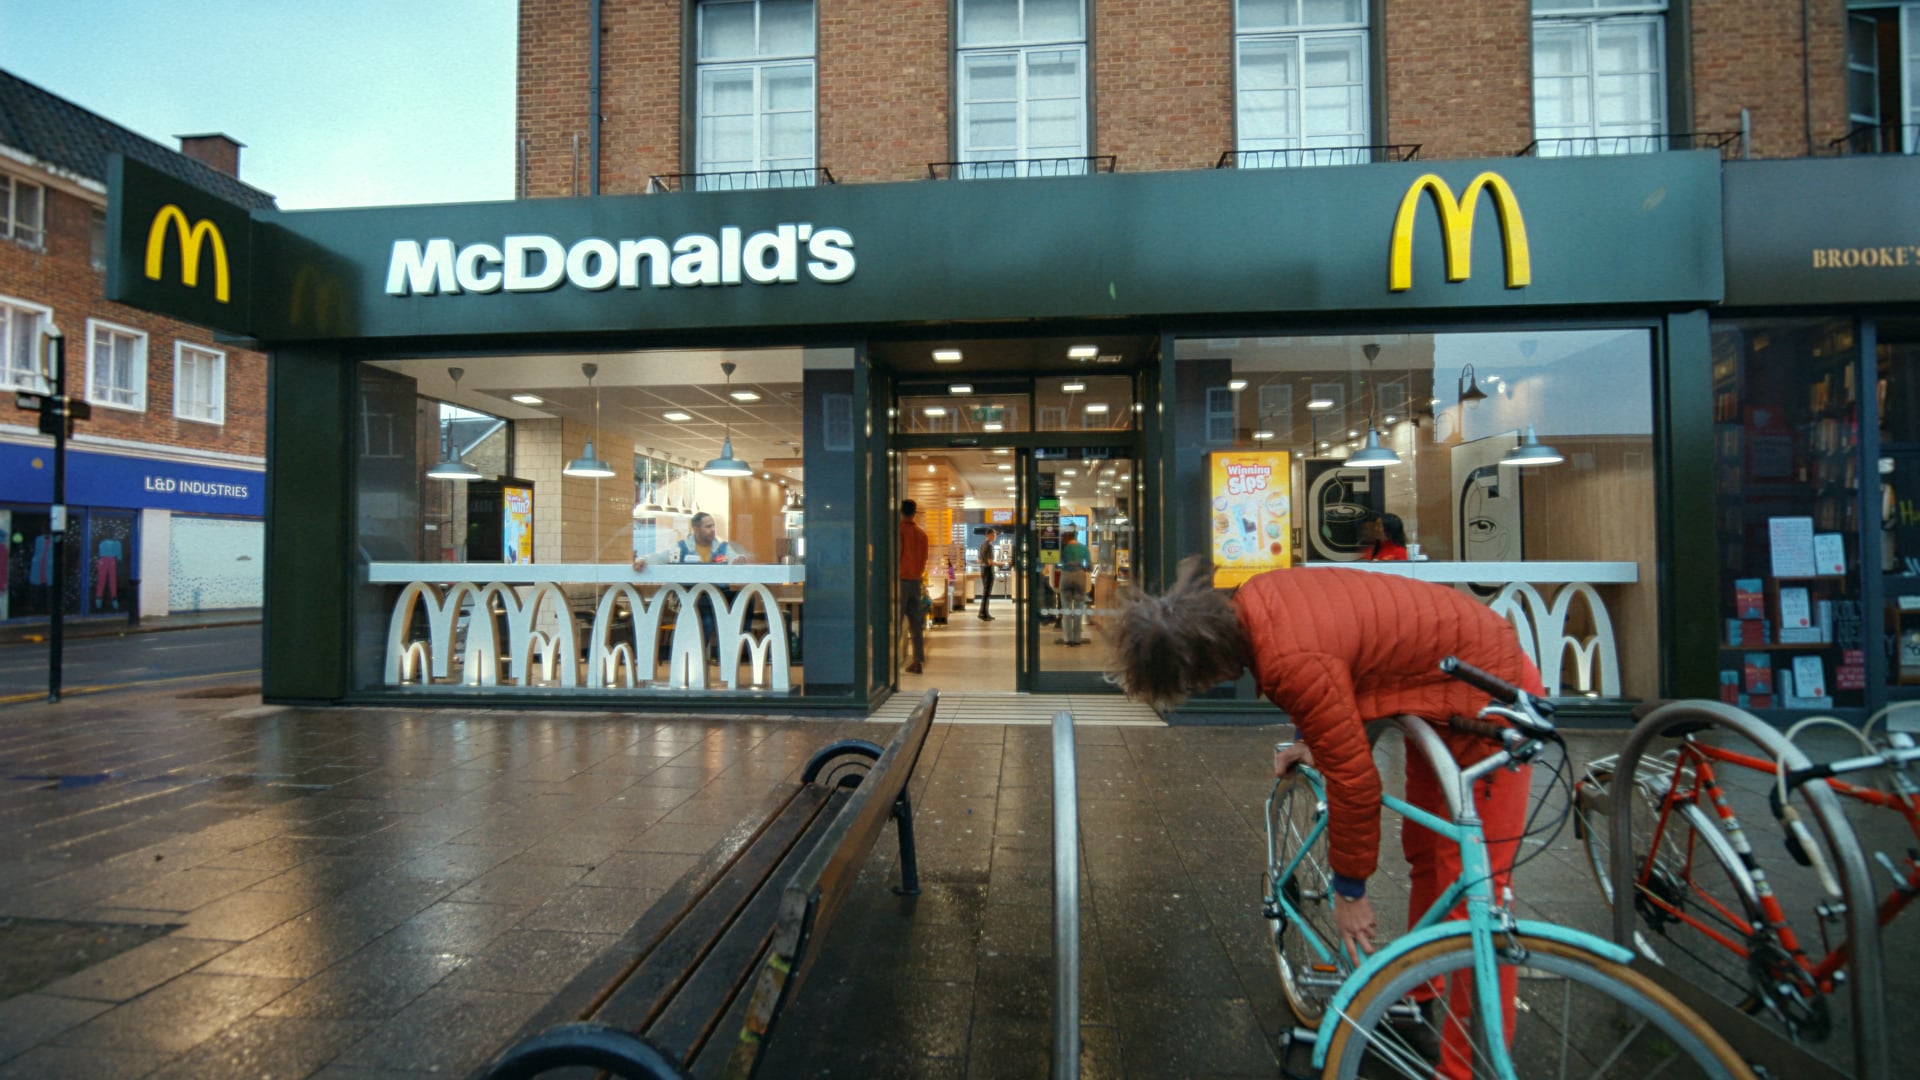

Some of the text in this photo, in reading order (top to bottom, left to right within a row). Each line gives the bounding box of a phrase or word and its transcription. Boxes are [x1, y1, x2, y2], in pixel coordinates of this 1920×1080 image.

[145, 203, 231, 304] M
[1390, 171, 1531, 291] M
[385, 224, 856, 295] McDonald's
[145, 476, 249, 498] L&D INDUSTRIES
[1227, 465, 1271, 476] Winning
[1228, 474, 1267, 494] Sips
